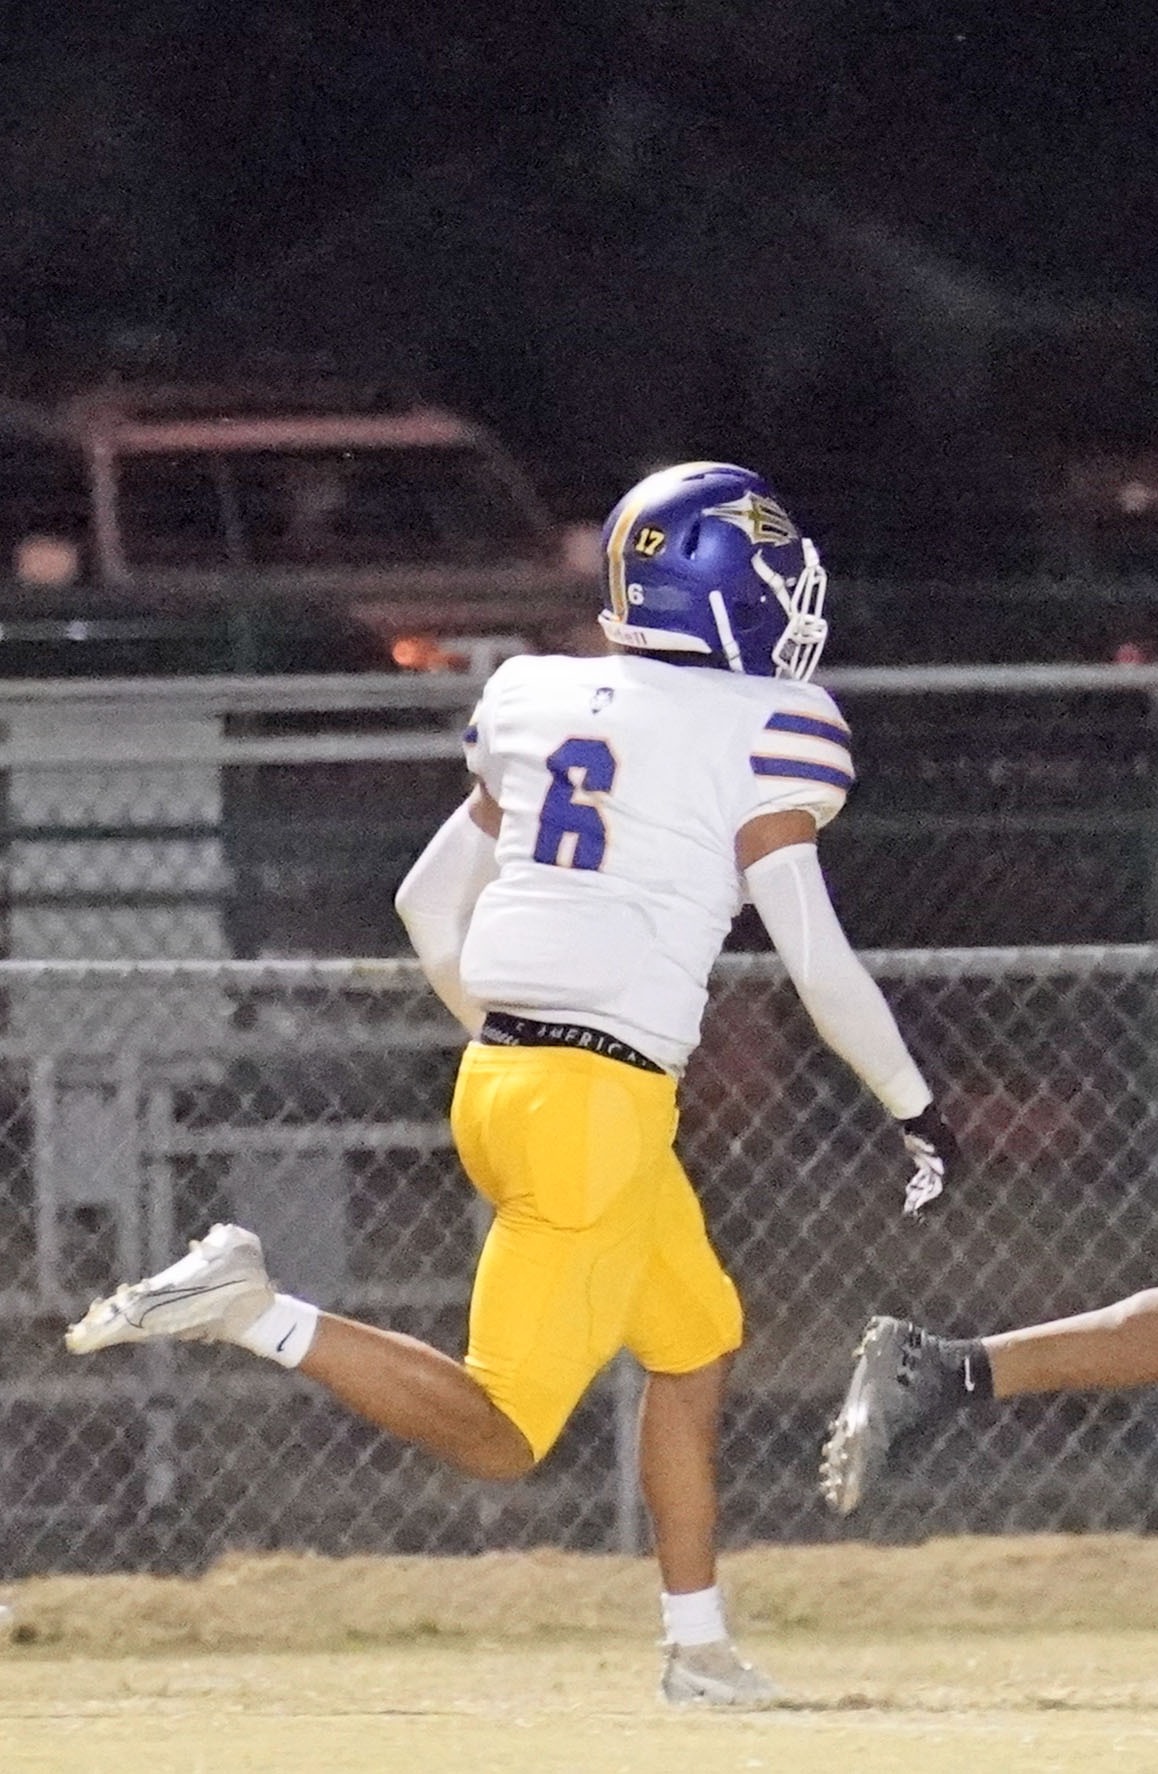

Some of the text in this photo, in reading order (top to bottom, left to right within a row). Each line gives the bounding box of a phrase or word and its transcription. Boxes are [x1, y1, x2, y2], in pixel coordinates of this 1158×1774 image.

[635, 528, 665, 556] 17
[627, 583, 645, 606] 6
[533, 737, 615, 870] 6
